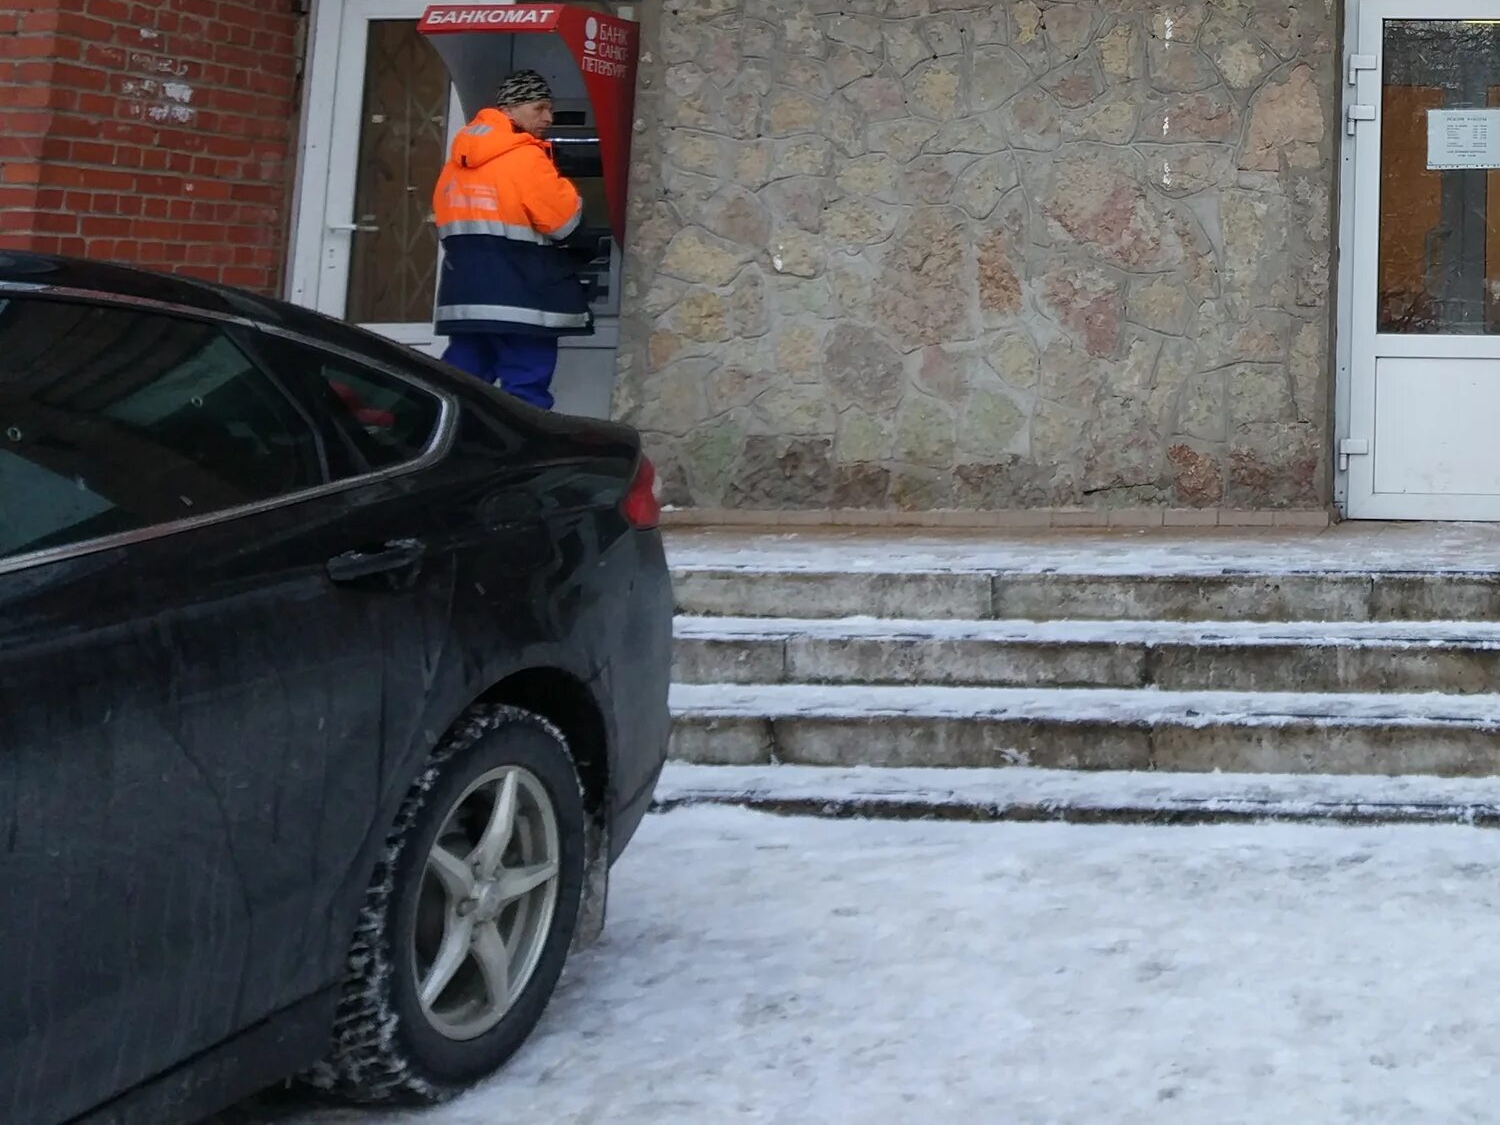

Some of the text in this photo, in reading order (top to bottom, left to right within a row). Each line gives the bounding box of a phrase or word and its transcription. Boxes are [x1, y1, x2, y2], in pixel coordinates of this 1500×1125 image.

[426, 10, 555, 24] БАНКОМАТ
[599, 23, 629, 43] БАНК
[598, 42, 629, 59] САНКТ-
[581, 57, 630, 78] ПЕТЕРБУРГ
